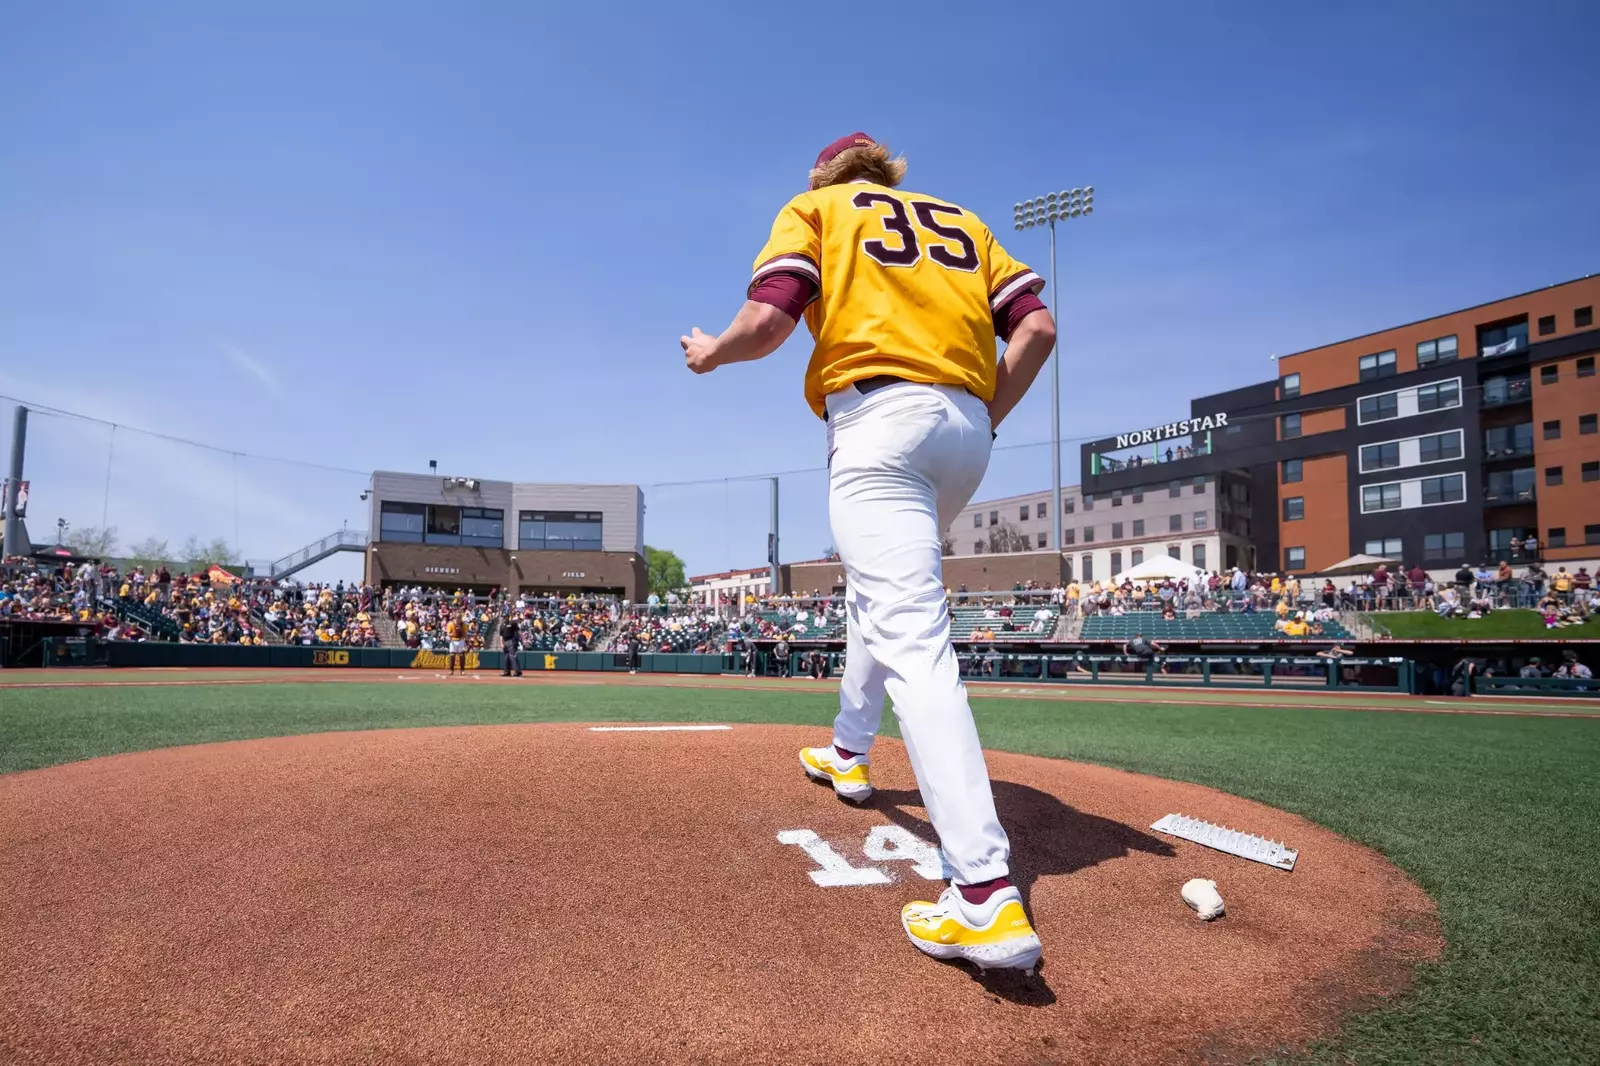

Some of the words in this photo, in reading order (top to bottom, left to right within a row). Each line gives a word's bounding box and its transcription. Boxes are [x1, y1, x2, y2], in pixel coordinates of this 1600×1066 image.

[852, 191, 981, 273] 35
[1116, 412, 1228, 448] NORTHSTAR
[776, 825, 952, 888] 14
